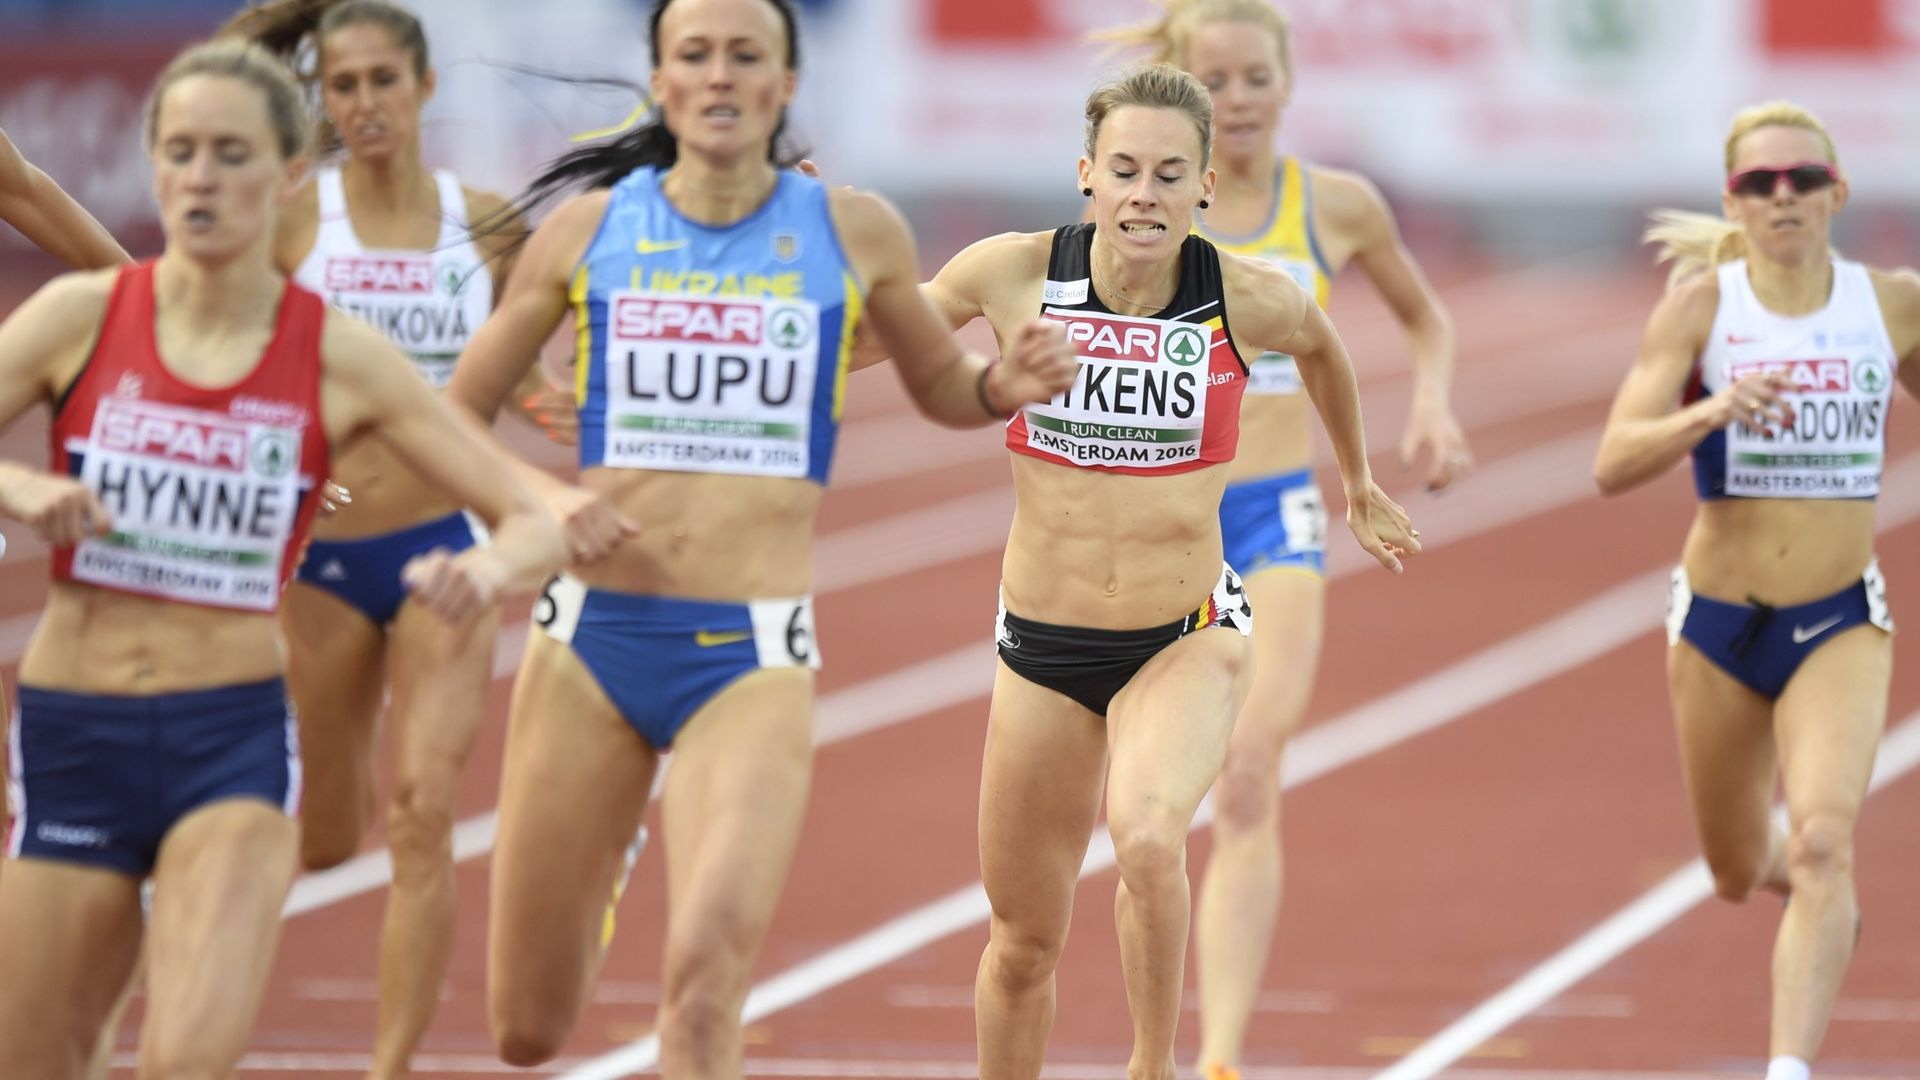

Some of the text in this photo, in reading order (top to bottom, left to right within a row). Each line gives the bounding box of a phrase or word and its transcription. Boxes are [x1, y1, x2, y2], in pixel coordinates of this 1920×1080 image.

[328, 262, 429, 290] SPAR
[618, 302, 760, 344] SPAR
[1042, 318, 1157, 358] PAR
[627, 351, 797, 408] LUPU
[1034, 362, 1197, 419] YKENS
[1206, 371, 1235, 387] elan
[102, 411, 244, 471] SPAR
[1032, 430, 1197, 462] AMSTERDAM 2016
[1062, 421, 1158, 441] I RUN CLEAN
[99, 462, 280, 539] HYNNE
